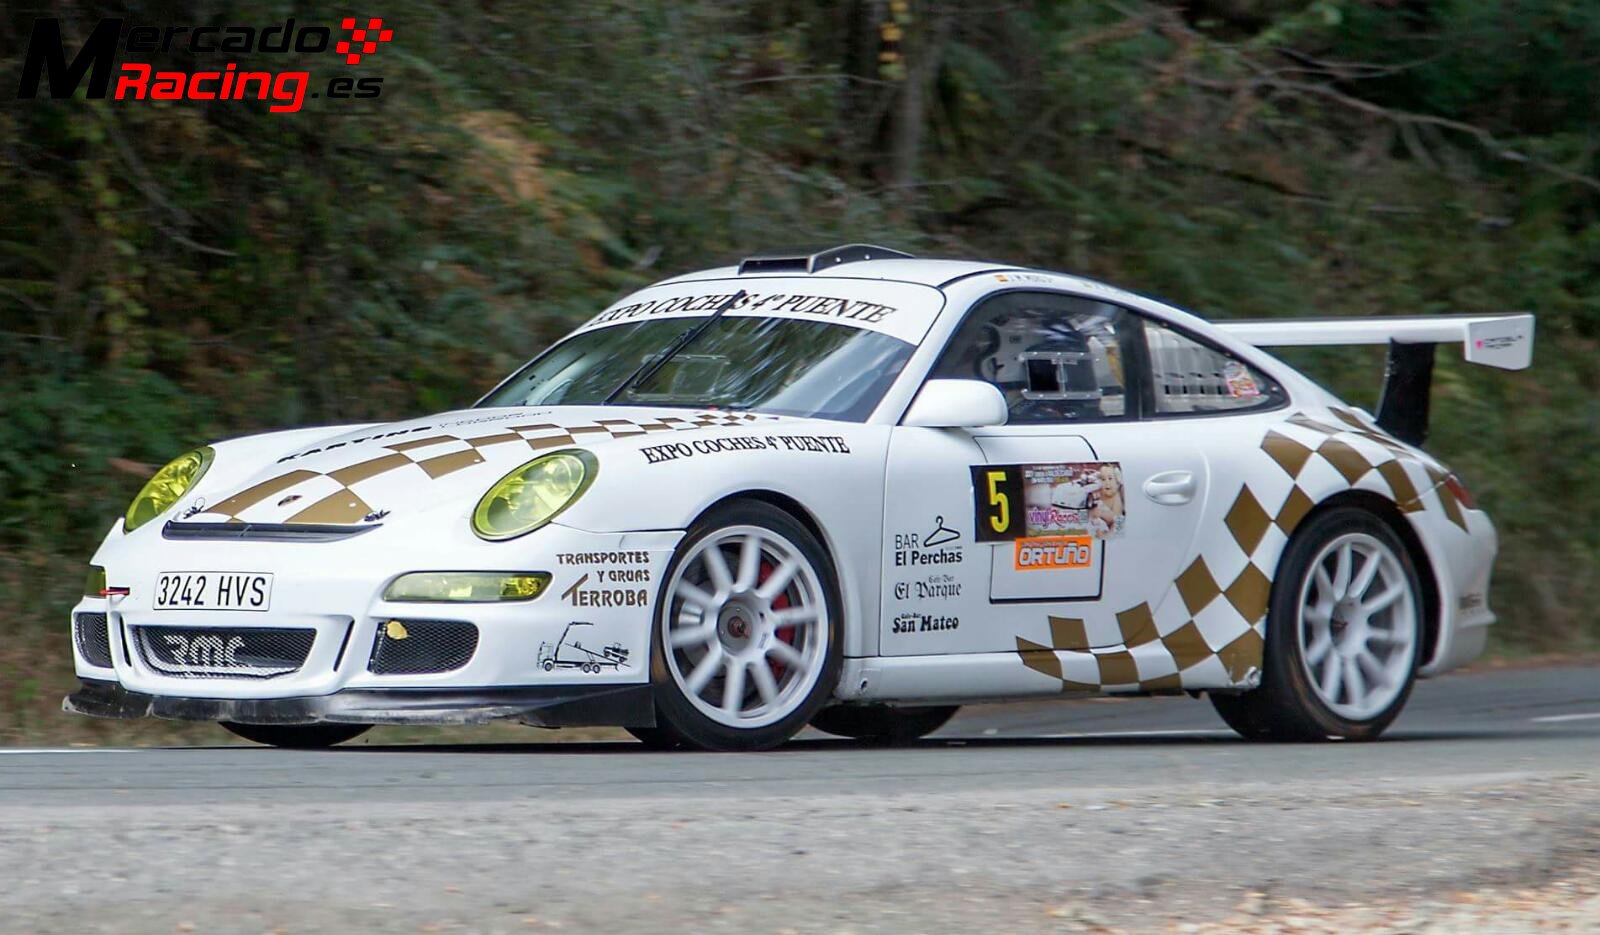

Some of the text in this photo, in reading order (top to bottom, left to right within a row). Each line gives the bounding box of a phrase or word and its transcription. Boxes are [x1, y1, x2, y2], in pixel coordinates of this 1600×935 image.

[586, 300, 657, 327] EXPO
[650, 293, 760, 315] COCHS
[772, 294, 897, 323] PUENTE
[638, 442, 693, 465] EXPO
[692, 436, 767, 455] COCHES
[776, 435, 851, 454] PUENTE
[986, 470, 1010, 533] 5
[895, 533, 919, 550] BAR
[556, 551, 650, 565] TRANSPORTES
[895, 548, 963, 567] El Perchas
[1019, 542, 1090, 566] ORTUÑO
[597, 569, 651, 583] Y GRUAS
[157, 575, 267, 606] 3242 HVS
[561, 573, 649, 608] TERROBA
[894, 581, 962, 600] El Parque
[892, 614, 960, 634] San Mateo
